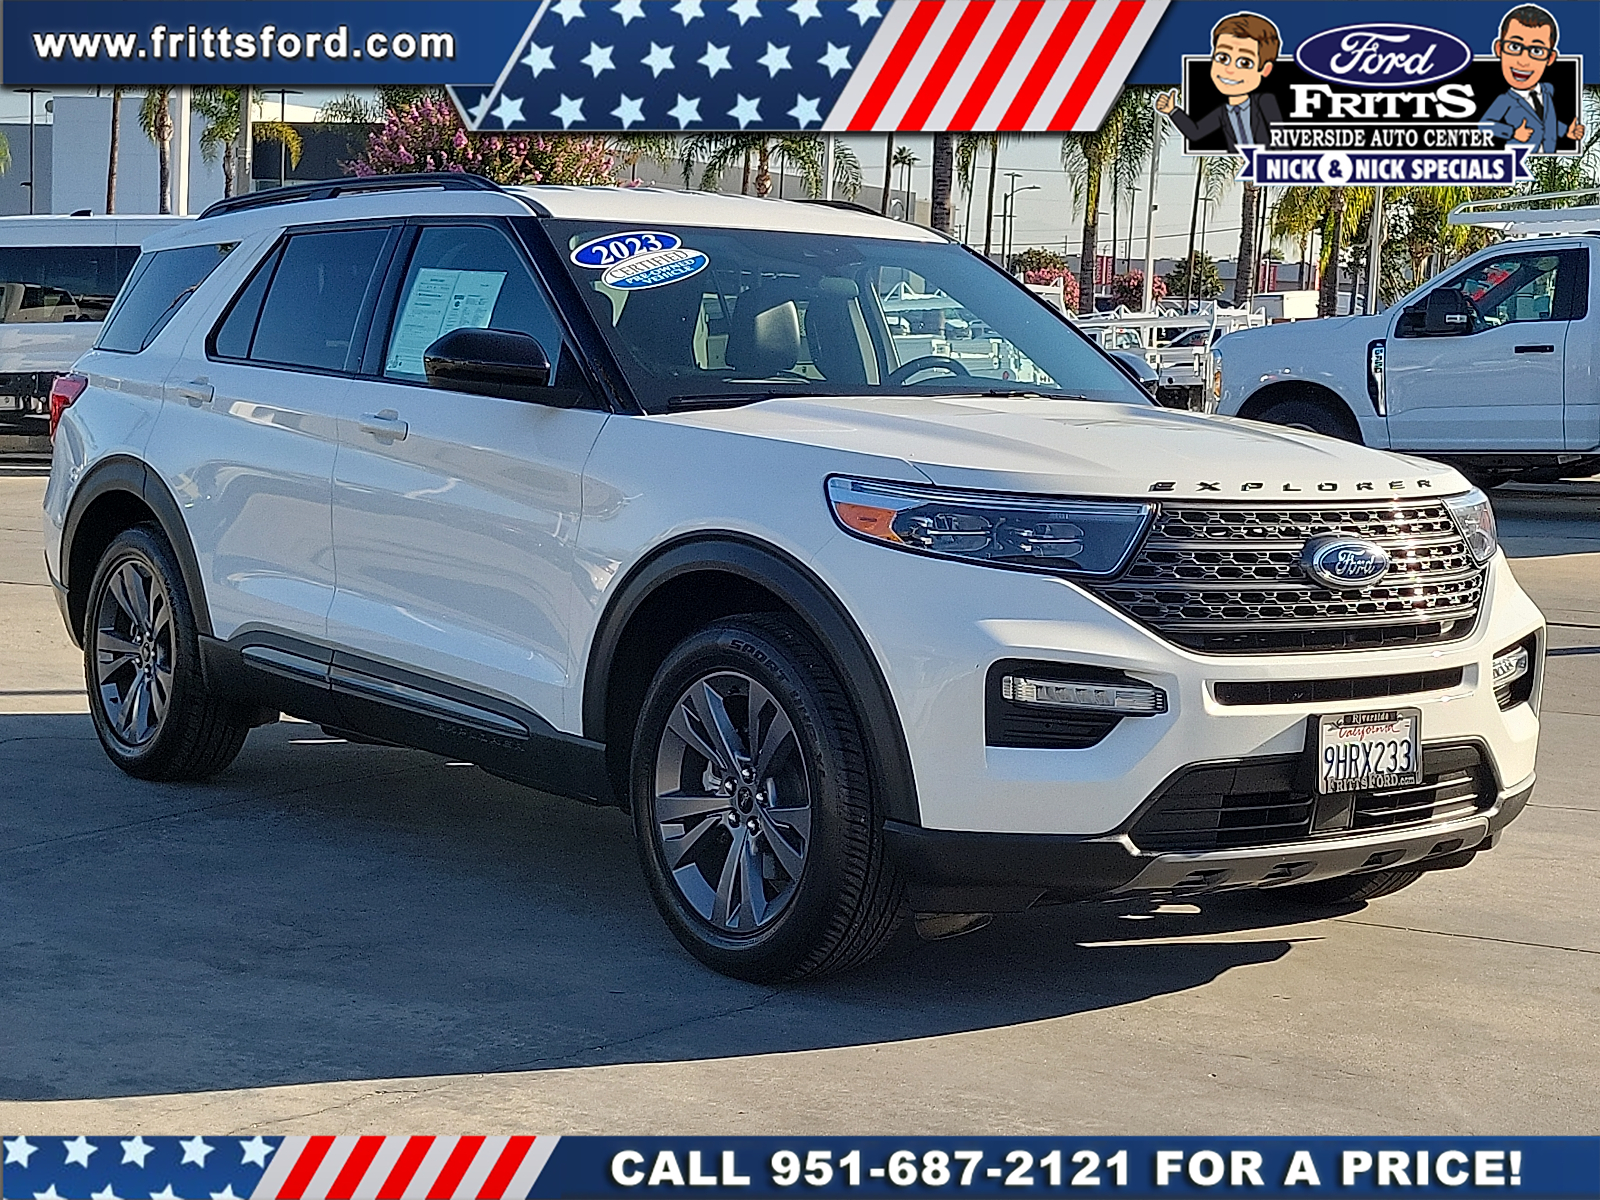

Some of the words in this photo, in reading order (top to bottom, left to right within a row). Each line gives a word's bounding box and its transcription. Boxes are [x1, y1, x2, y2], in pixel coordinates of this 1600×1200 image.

[592, 234, 662, 265] 2023
[610, 250, 689, 279] CERTIFIED
[1149, 479, 1432, 492] EXPLORER
[1335, 549, 1375, 575] Ford
[1324, 740, 1412, 780] 9HRX233
